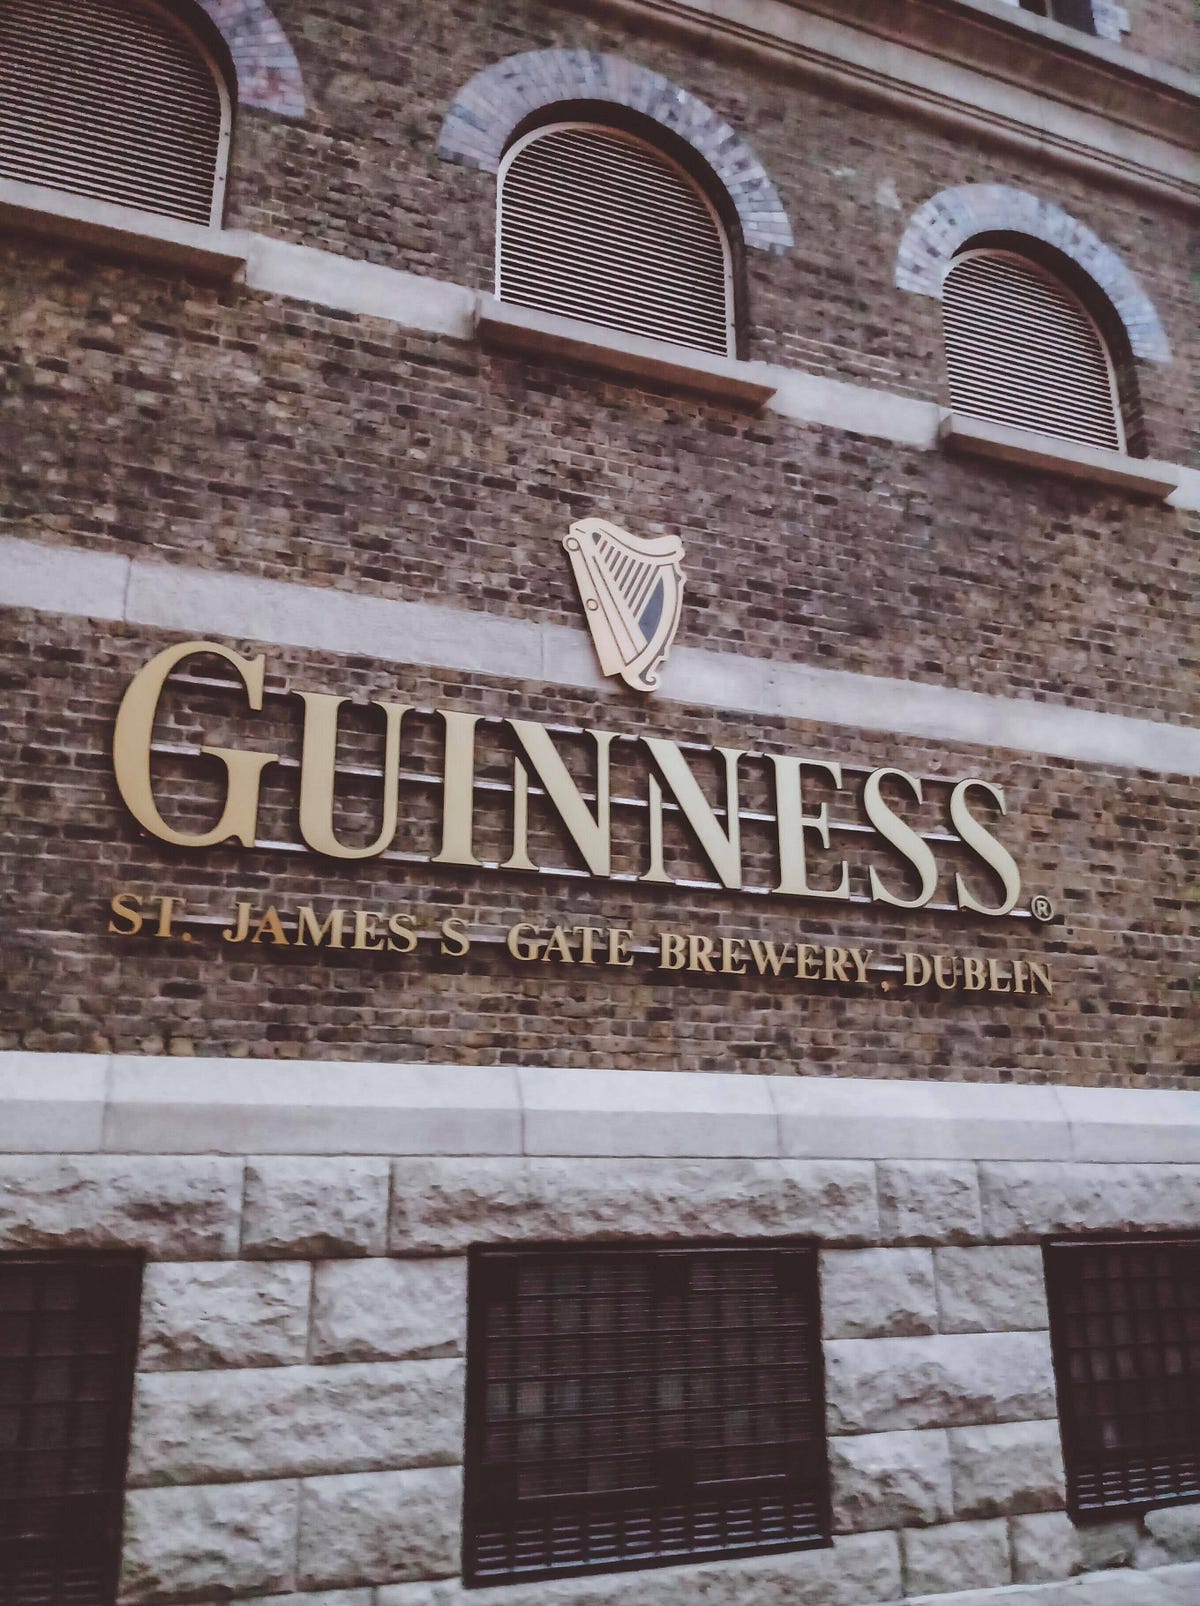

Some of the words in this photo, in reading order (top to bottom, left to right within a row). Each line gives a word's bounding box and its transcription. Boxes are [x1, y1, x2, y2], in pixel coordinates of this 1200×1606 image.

[113, 641, 1021, 916] GUINNESS
[108, 893, 192, 942] ST.
[507, 922, 634, 966] GATE
[903, 952, 1053, 995] DUBLIN
